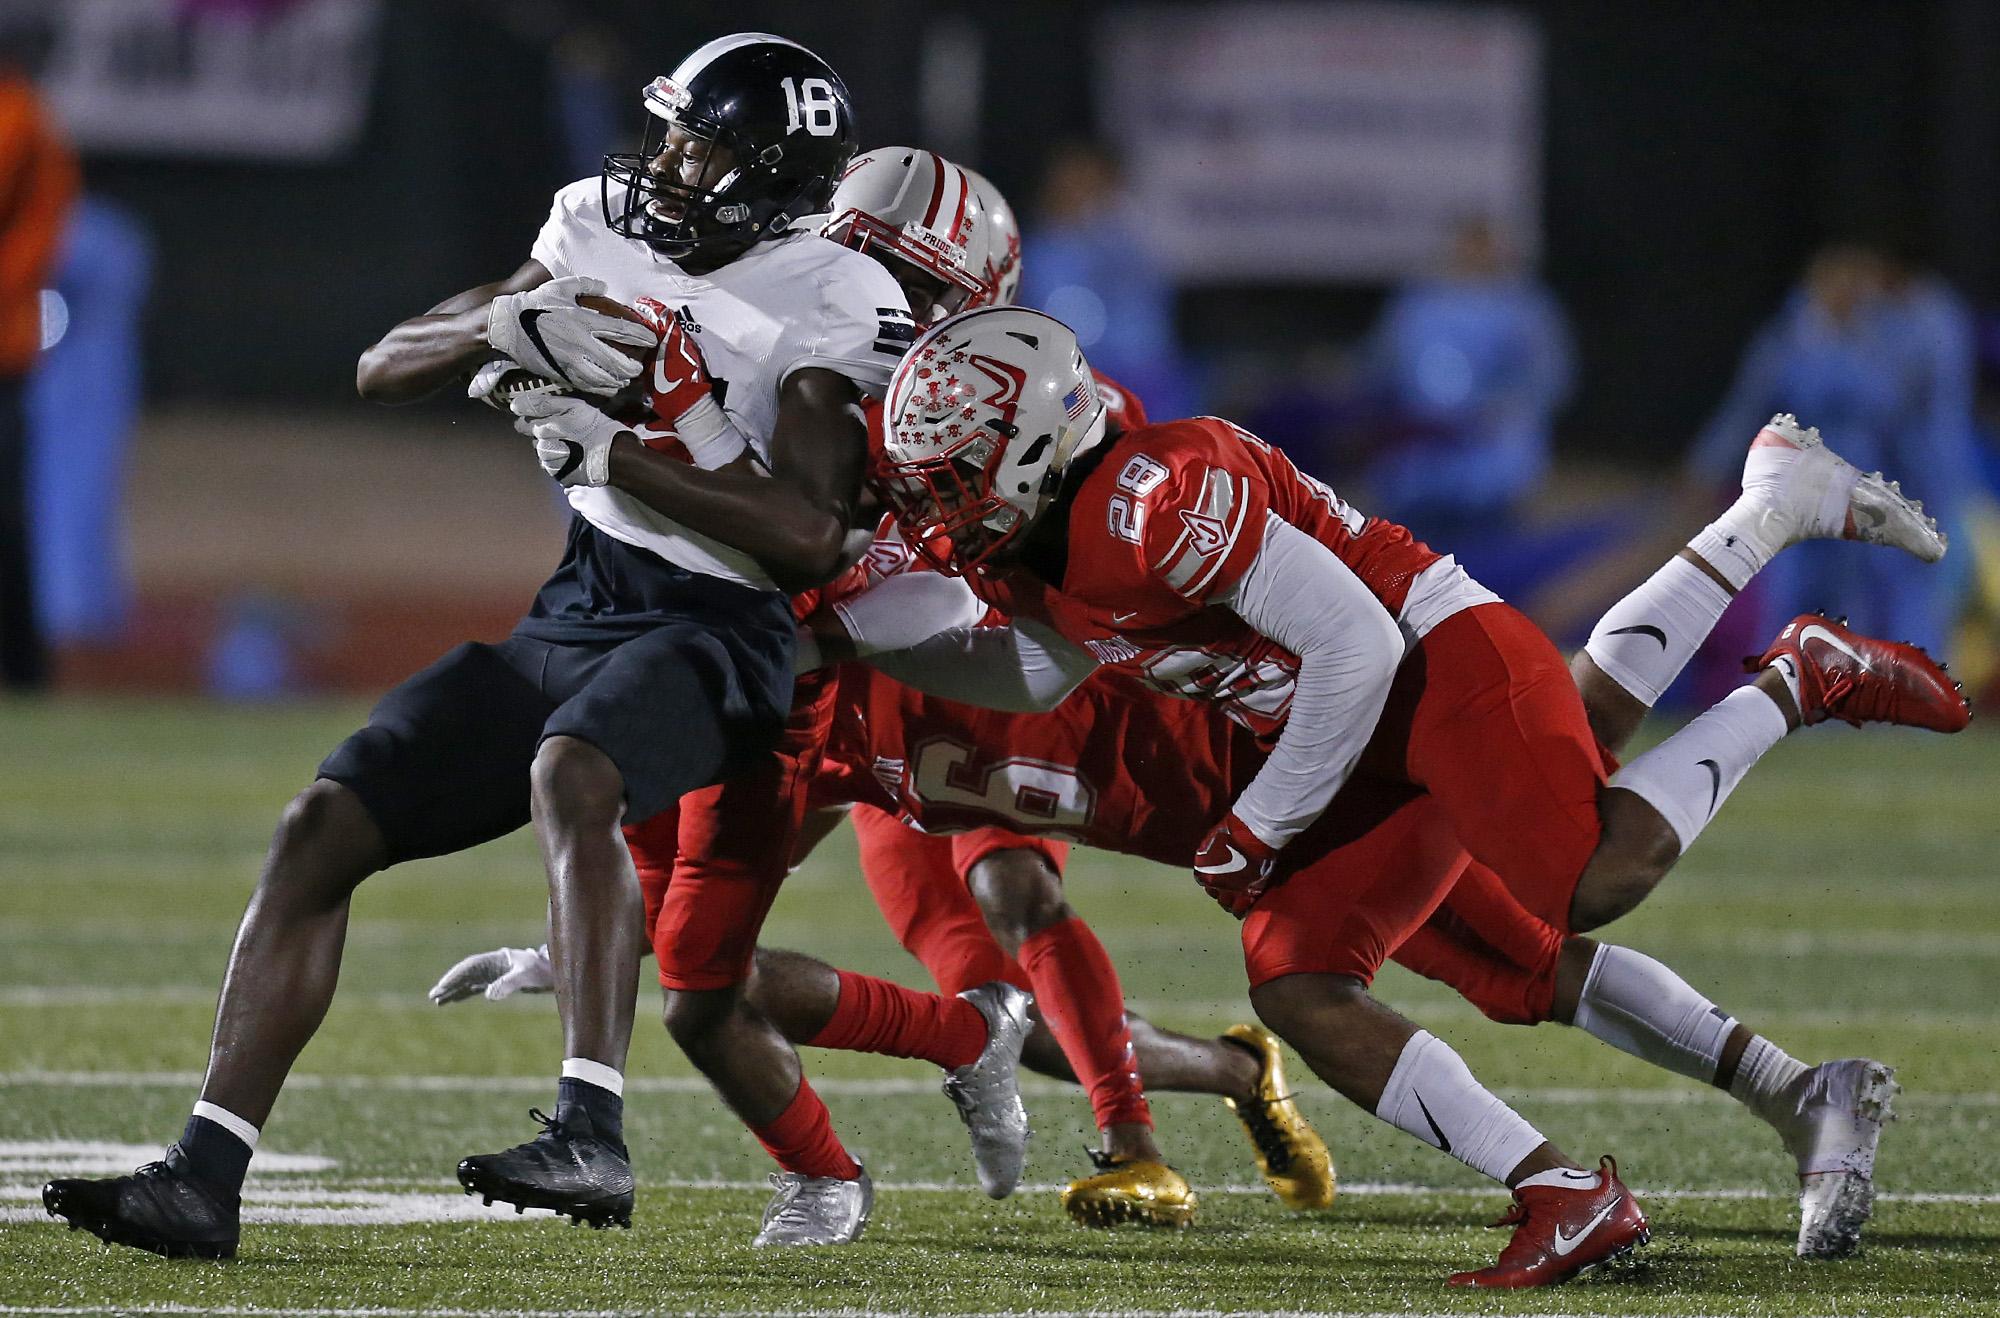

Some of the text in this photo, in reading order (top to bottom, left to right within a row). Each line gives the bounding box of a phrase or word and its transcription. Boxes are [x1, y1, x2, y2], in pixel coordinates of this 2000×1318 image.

[780, 77, 838, 136] 16
[923, 232, 951, 254] PRIDE
[1107, 452, 1170, 546] 28
